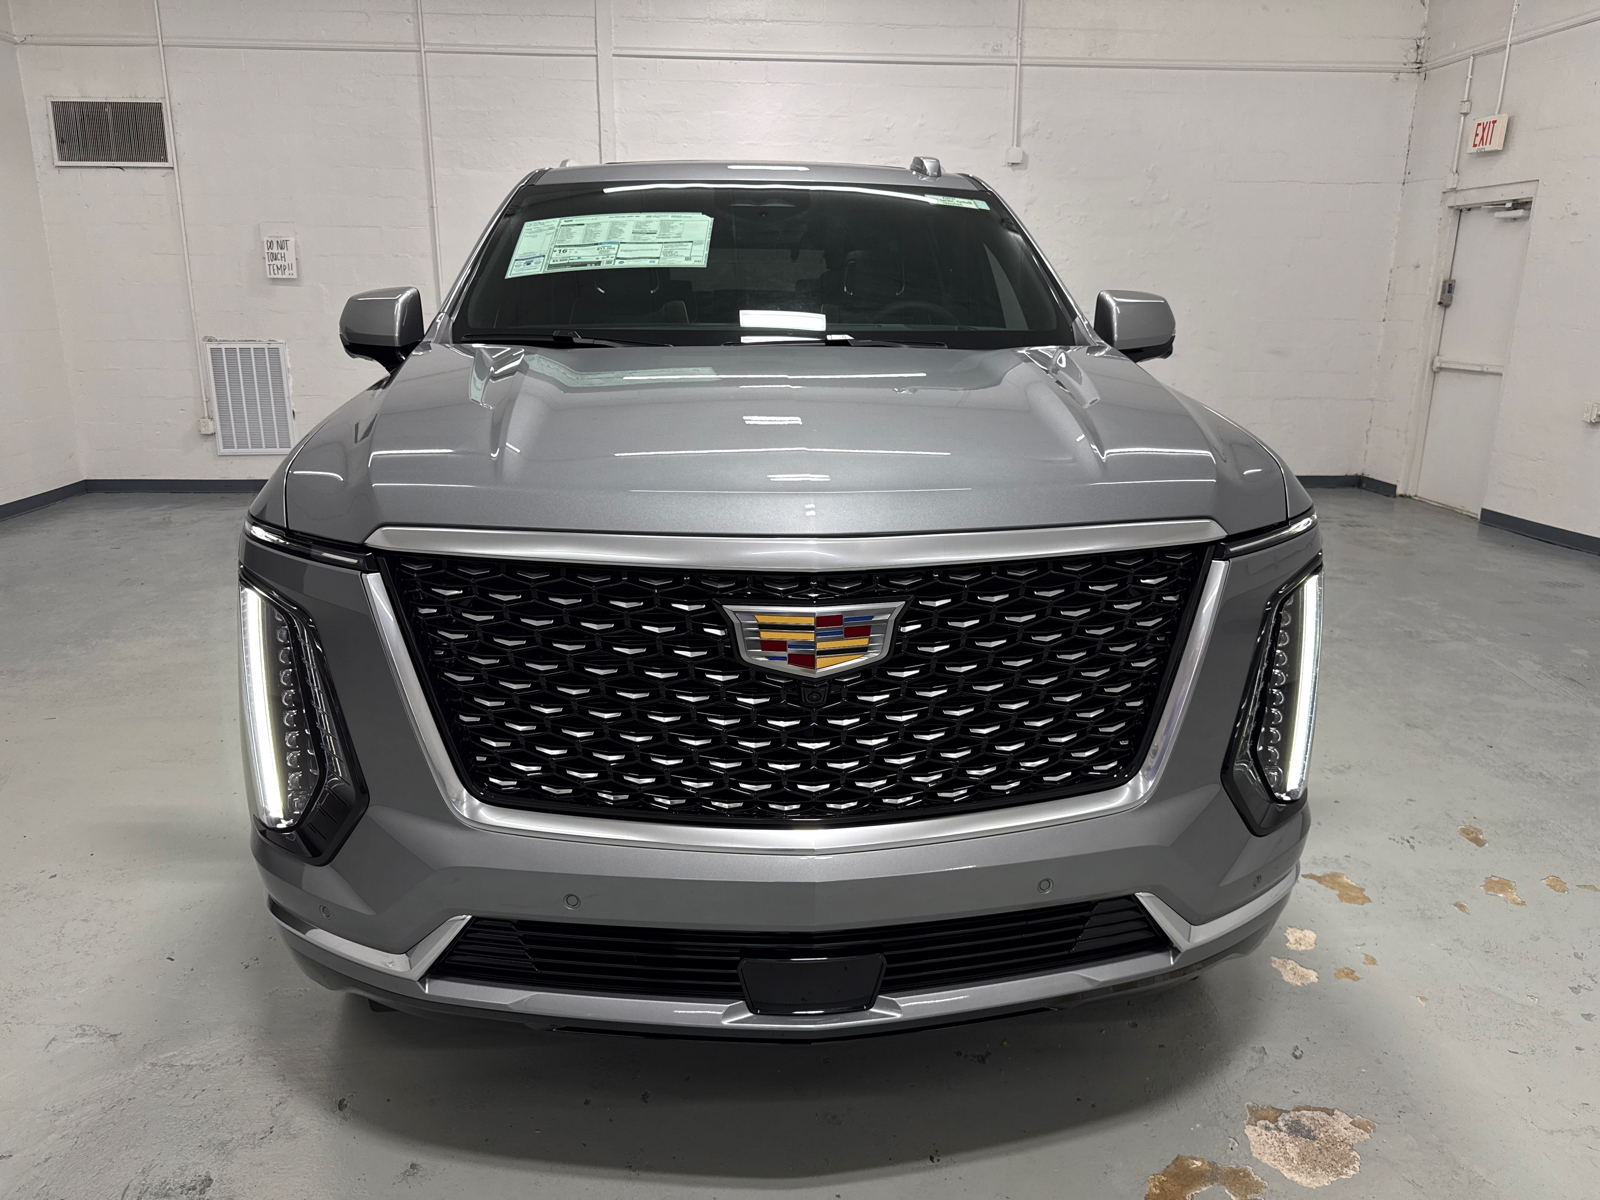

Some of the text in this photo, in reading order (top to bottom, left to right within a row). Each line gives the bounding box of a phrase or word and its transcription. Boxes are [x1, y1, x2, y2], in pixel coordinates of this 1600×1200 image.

[1472, 119, 1498, 148] EXIT
[266, 239, 290, 251] DO NOT
[265, 251, 287, 263] TOUCH
[267, 262, 294, 276] TEMP!!
